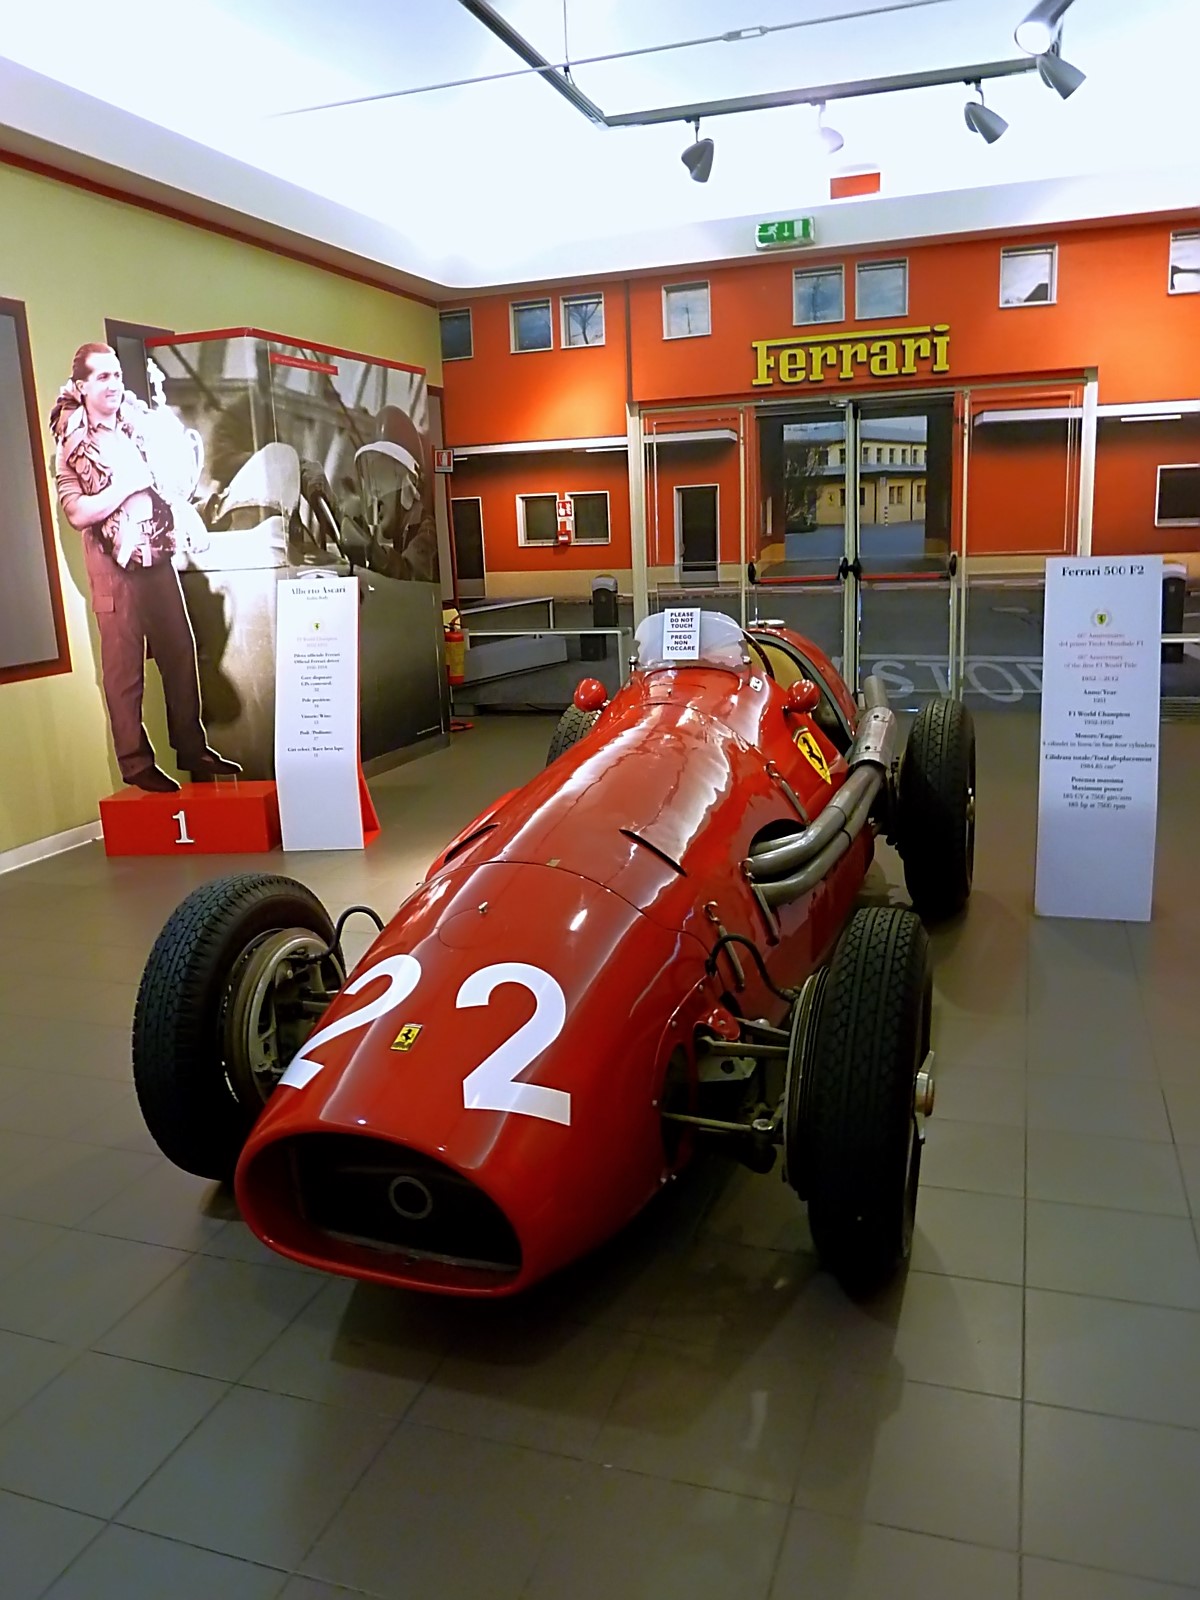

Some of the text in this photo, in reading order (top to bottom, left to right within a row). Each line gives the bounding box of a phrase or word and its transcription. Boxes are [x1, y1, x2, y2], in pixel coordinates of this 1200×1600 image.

[751, 324, 950, 386] Ferrari
[1062, 565, 1144, 577] Ferrari 500 F2
[172, 810, 195, 844] 1
